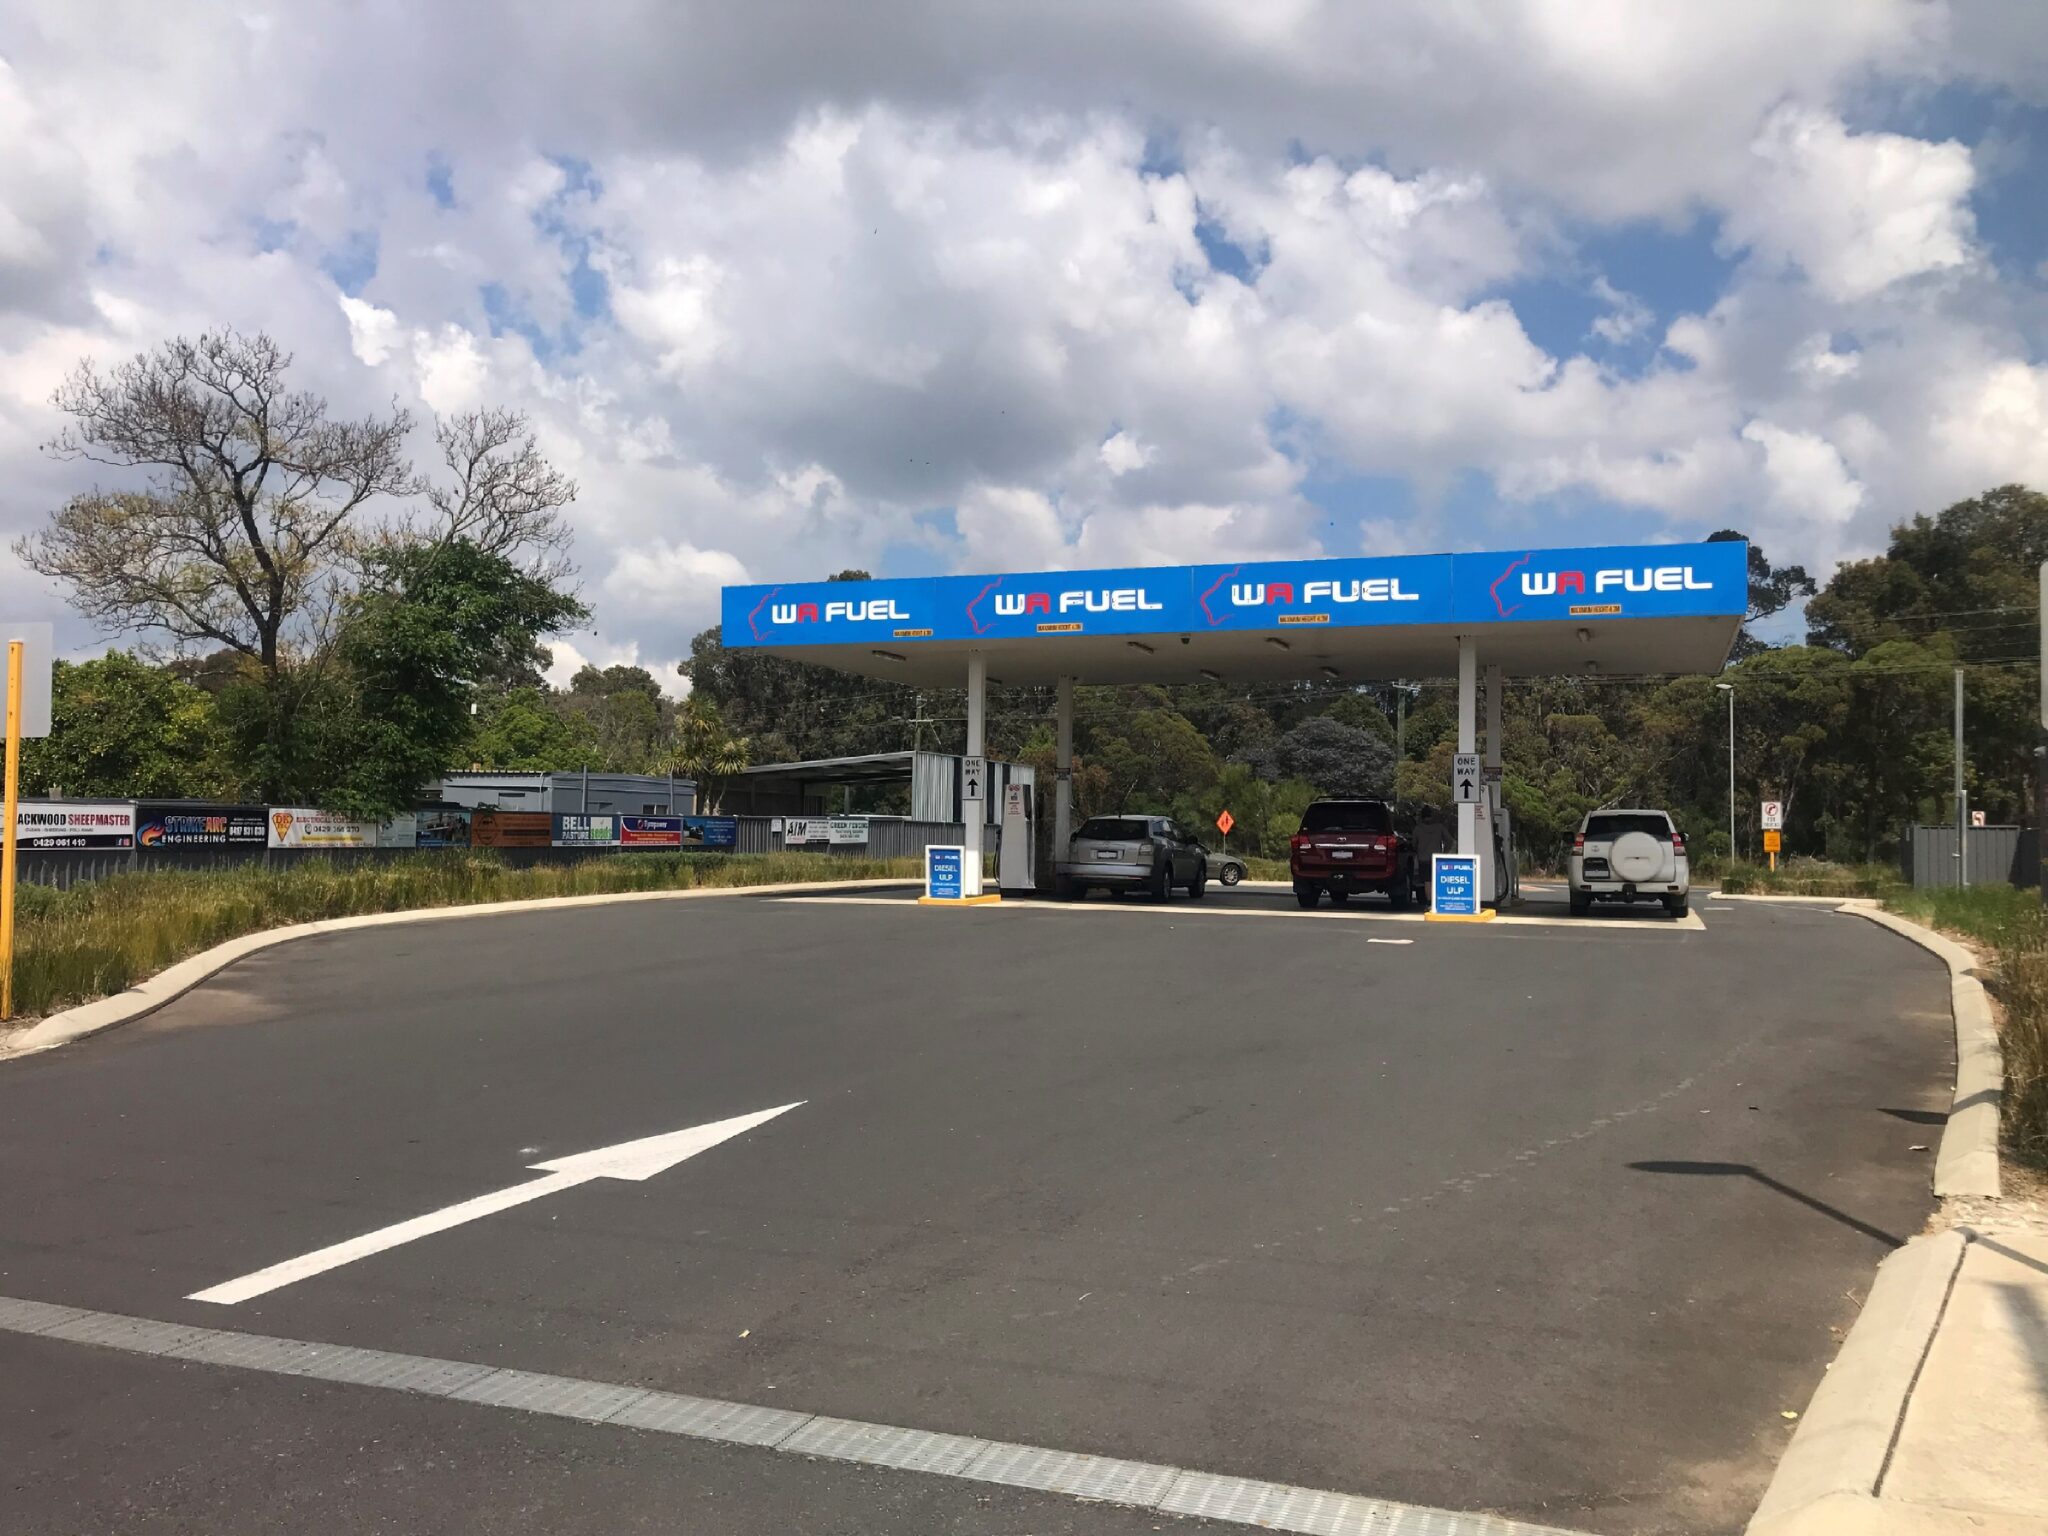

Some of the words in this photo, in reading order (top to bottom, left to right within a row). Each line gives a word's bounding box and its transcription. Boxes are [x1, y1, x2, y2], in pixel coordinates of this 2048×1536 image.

[1521, 571, 1585, 596] WA
[1595, 566, 1713, 593] FUEL
[1231, 582, 1293, 606] WA
[1303, 578, 1420, 604] FUEL
[995, 593, 1051, 616] WA
[1059, 589, 1163, 613] FUEL
[772, 603, 819, 624] WA
[825, 599, 910, 622] FUEL
[965, 759, 981, 767] ONE
[1457, 757, 1476, 766] ONE
[965, 768, 981, 776] WAY
[1457, 767, 1476, 775] WAY
[17, 813, 67, 825] ACKWOOD
[68, 814, 131, 826] SHEEPMASTER
[562, 816, 590, 831] BELL
[161, 834, 226, 843] ENGINEERING
[561, 831, 589, 840] PASTURE
[934, 864, 958, 872] DIESEL
[939, 873, 954, 881] ULP
[1440, 875, 1471, 885] DIESEL
[1446, 886, 1465, 895] ULP
